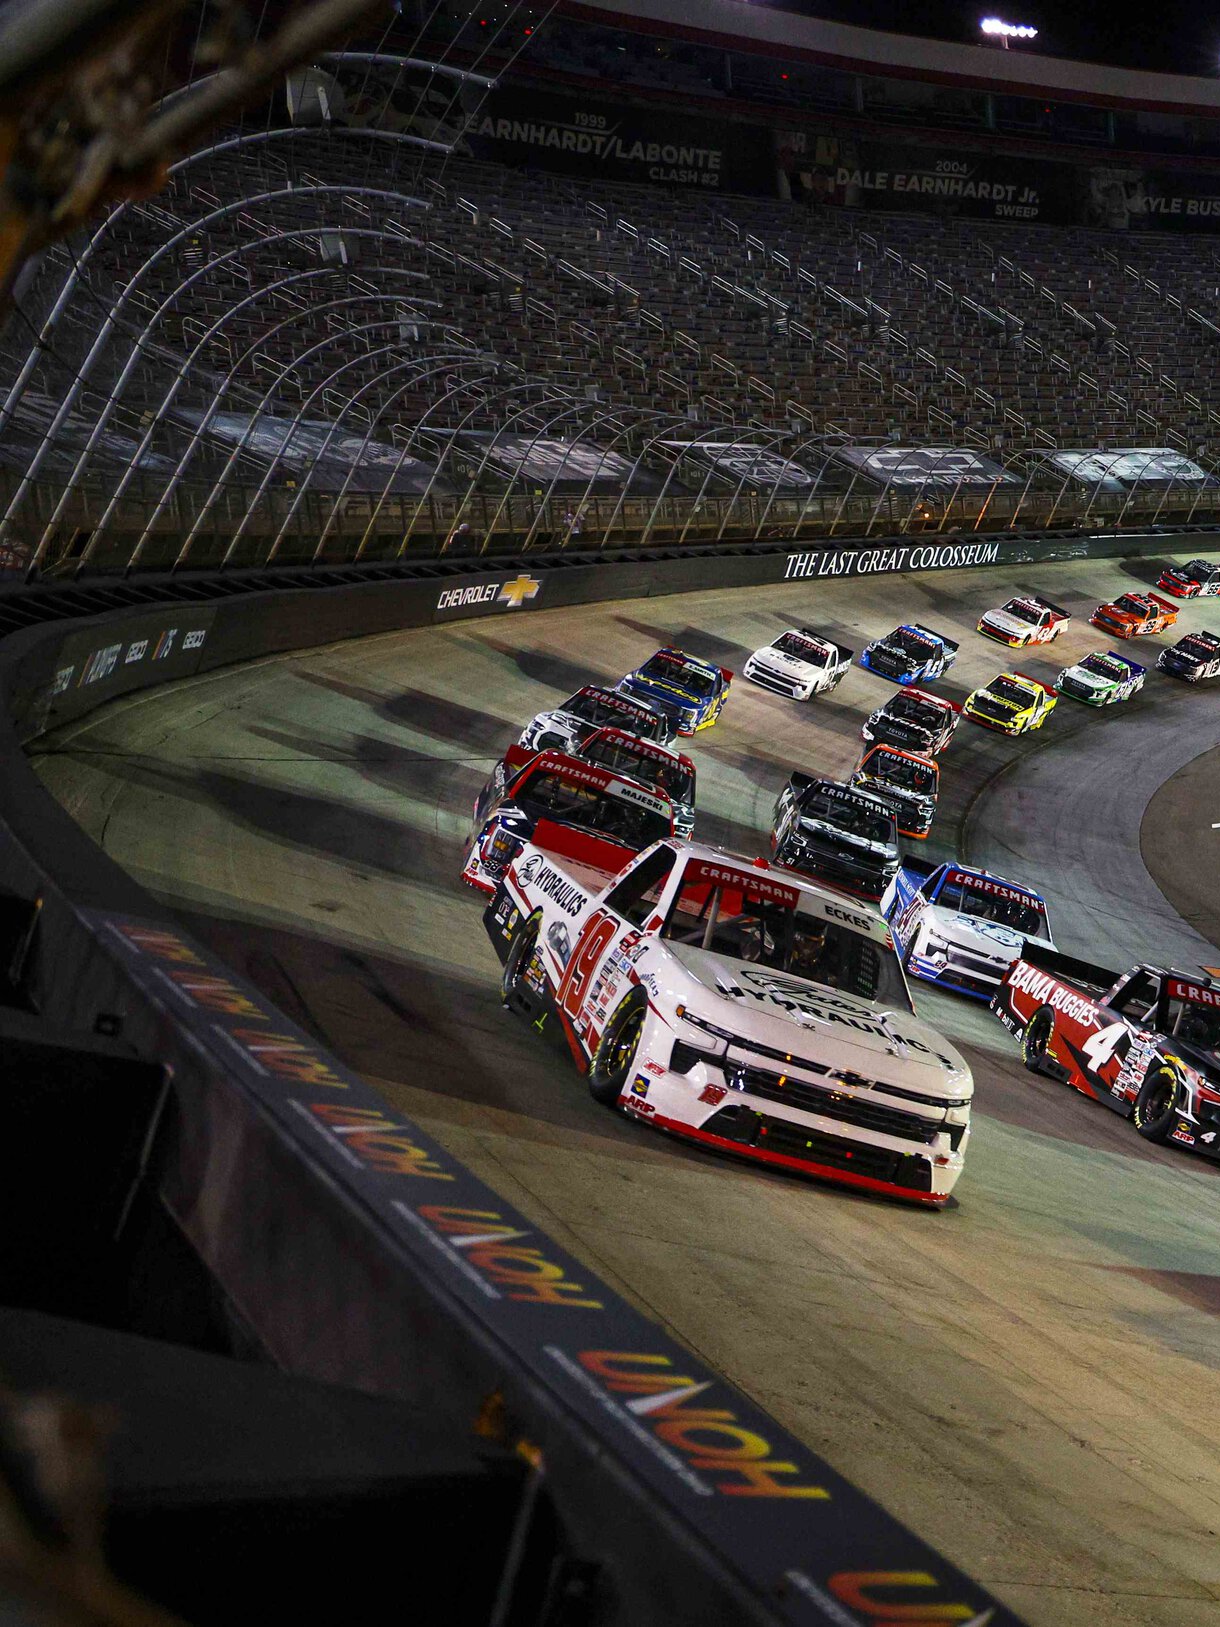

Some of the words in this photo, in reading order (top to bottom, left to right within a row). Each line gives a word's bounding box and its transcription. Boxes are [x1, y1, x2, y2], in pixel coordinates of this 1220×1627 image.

[574, 111, 607, 130] 1999
[649, 167, 698, 184] CLASH
[700, 173, 720, 187] #2
[935, 160, 968, 173] 2004
[836, 167, 889, 190] DALE
[893, 174, 1017, 201] EARNHARDT
[1018, 186, 1041, 204] Jr.
[995, 204, 1039, 218] SWEEP
[784, 552, 819, 578] THE
[817, 551, 858, 575] LAST
[857, 548, 909, 573] GREAT
[909, 543, 1000, 568] COLOSSEUM
[437, 583, 500, 609] CHEVROLET
[585, 689, 655, 722] CRAFTSMAN
[888, 727, 908, 738] TOYOTA
[606, 734, 689, 774] CRAFTSMAN
[879, 751, 933, 775] CRAFTSMAN
[540, 759, 587, 788] CRAFTSMAN
[621, 787, 664, 812] MAJESKI
[821, 786, 891, 818] CRAFTSMAN
[534, 866, 588, 917] HYDRAULICS
[700, 866, 794, 901] CRAFTSMAN
[824, 905, 872, 932] ECKES
[954, 873, 1039, 910] CRAFTSMAN
[555, 907, 621, 1020] 19
[1008, 960, 1057, 1005] BAMA
[1052, 986, 1100, 1028] BUGGIES
[232, 1028, 350, 1090] UNOH
[1082, 1021, 1129, 1073] 4
[626, 1094, 656, 1114] ARP
[308, 1103, 457, 1182] UNOH
[1172, 1130, 1195, 1144] ARP
[1201, 1131, 1217, 1144] 4
[416, 1204, 605, 1311] UNOH
[576, 1350, 832, 1500] UNOH
